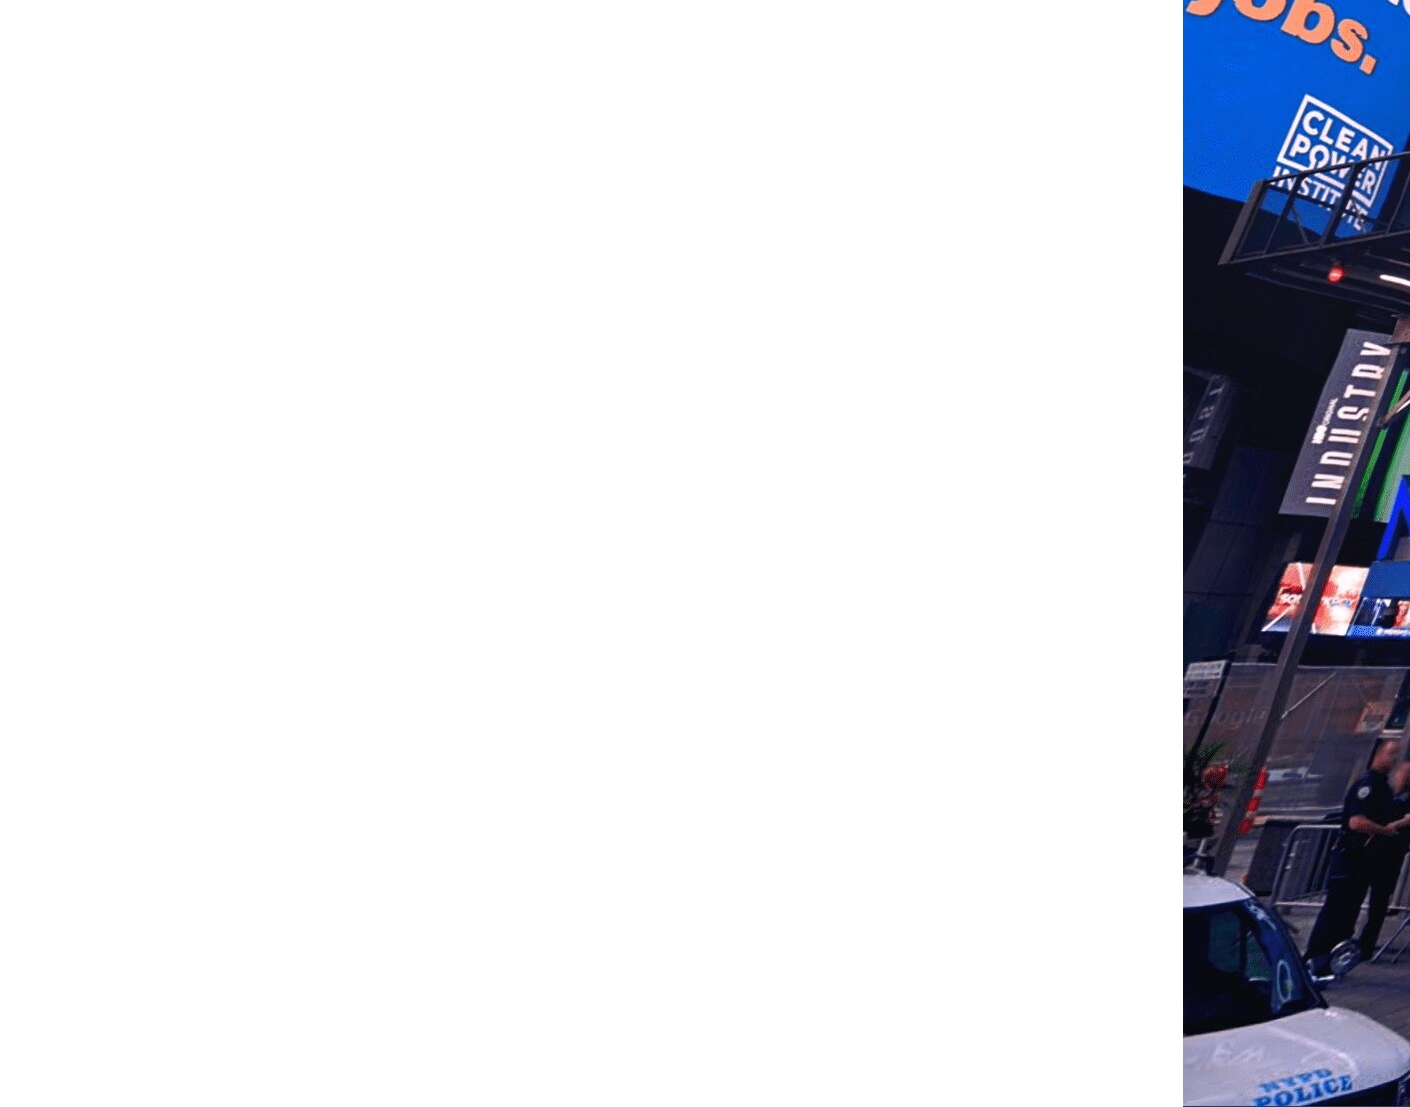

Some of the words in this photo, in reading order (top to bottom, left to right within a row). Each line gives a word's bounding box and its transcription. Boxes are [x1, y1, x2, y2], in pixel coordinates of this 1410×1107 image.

[1302, 109, 1387, 173] CLEAN
[1305, 340, 1393, 506] INDUSTRY
[1253, 1074, 1353, 1106] POLICE
[1258, 1068, 1333, 1093] NYPD
